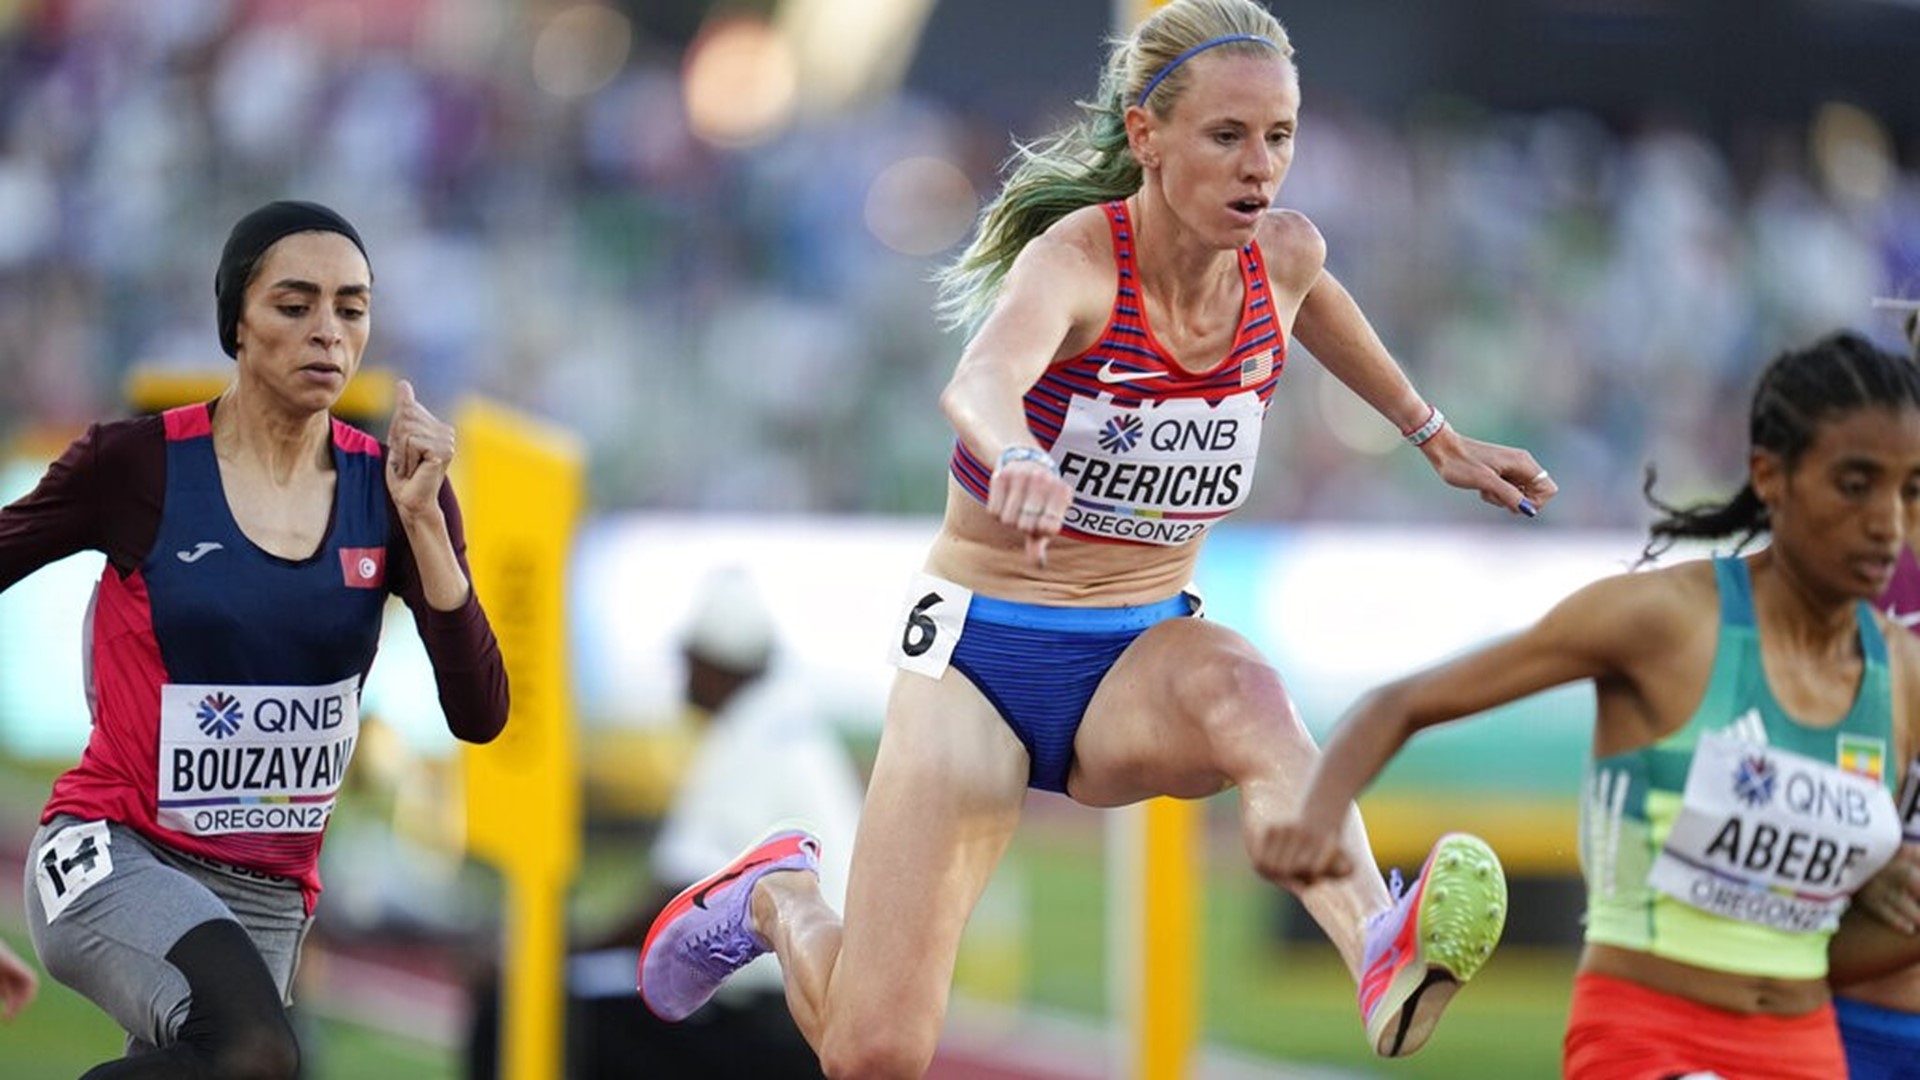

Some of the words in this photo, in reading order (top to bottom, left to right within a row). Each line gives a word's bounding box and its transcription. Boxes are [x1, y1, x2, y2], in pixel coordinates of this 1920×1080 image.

[1151, 419, 1239, 452] QNB
[1059, 451, 1243, 508] FRERICHS
[901, 592, 944, 657] 6
[253, 695, 343, 733] QNB
[1786, 771, 1871, 827] QNB
[42, 836, 99, 898] 14
